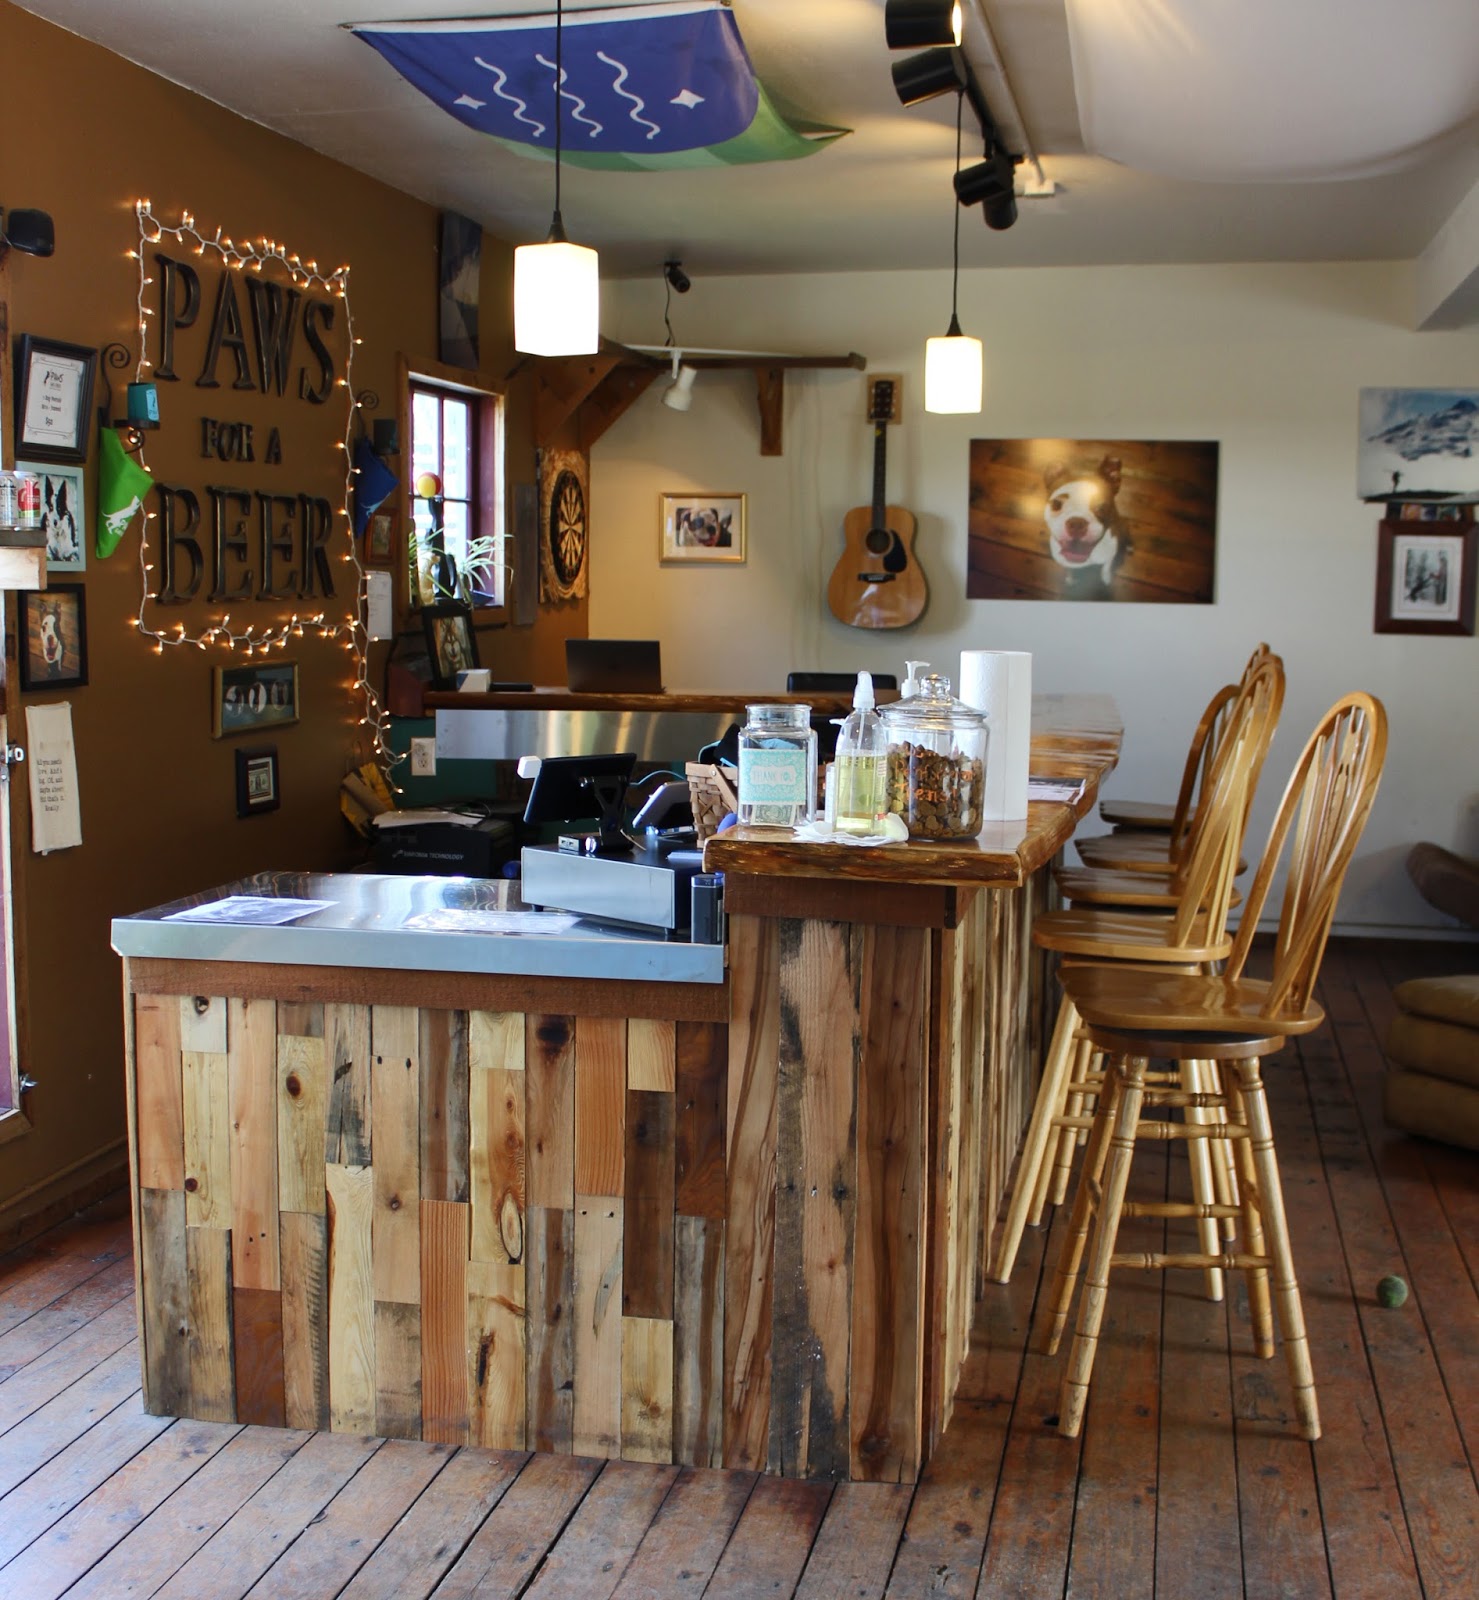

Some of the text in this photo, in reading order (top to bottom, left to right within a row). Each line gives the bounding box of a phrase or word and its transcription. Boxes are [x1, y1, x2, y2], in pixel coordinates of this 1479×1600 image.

[153, 254, 335, 405] PAWS
[200, 416, 282, 465] FOR A
[155, 482, 338, 605] BEER
[752, 770, 777, 782] THANK
[429, 852, 465, 861] TECHNOLOGY
